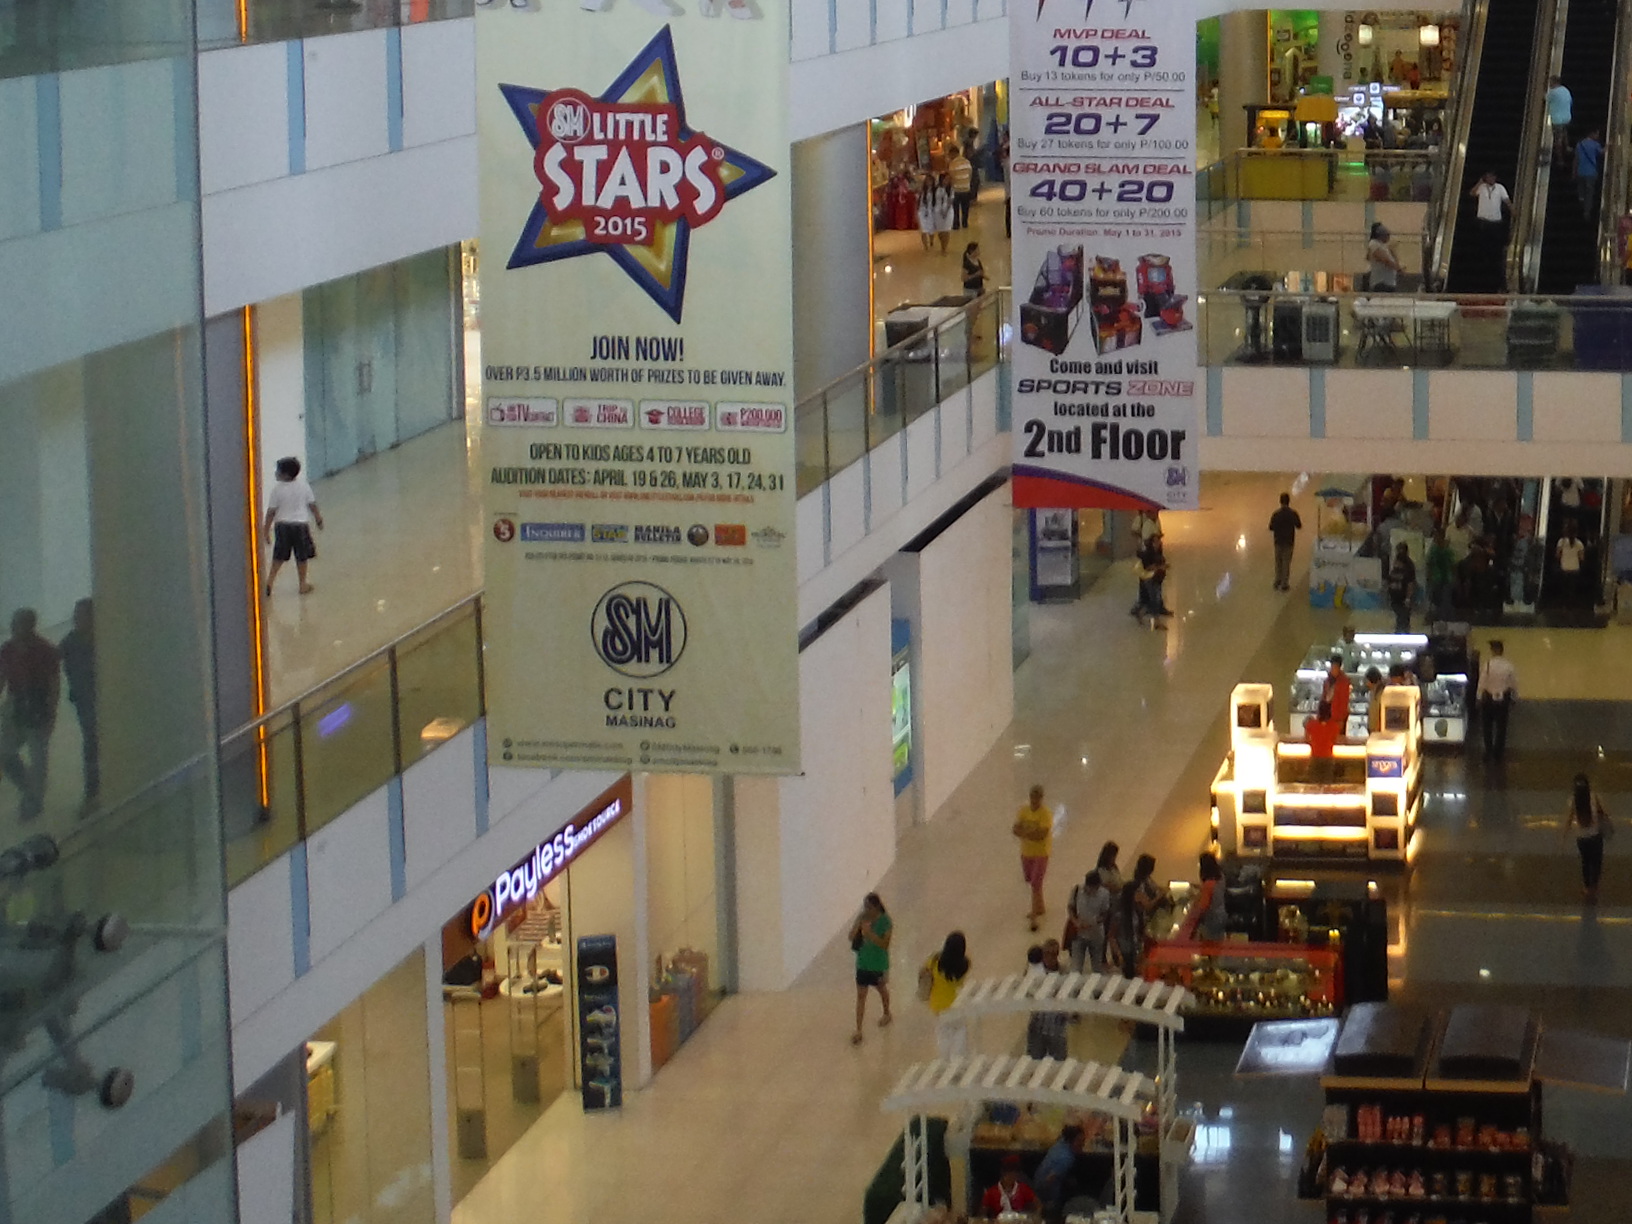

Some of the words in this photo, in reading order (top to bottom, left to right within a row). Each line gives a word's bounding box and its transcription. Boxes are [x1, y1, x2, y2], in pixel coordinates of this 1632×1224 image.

[1053, 28, 1098, 39] MVP
[1101, 29, 1151, 40] DEAL
[1021, 71, 1042, 83] Buy
[1046, 71, 1058, 81] 13
[1061, 71, 1097, 81] tokens
[1101, 72, 1114, 81] for
[1117, 72, 1141, 83] only
[1125, 97, 1175, 108] DEAL
[593, 113, 668, 141] LITTLE
[1018, 138, 1038, 150] Buy
[1058, 139, 1093, 149] tokens
[1097, 139, 1111, 149] for
[1114, 139, 1136, 151] only
[543, 142, 716, 215] STARS
[1013, 163, 1081, 174] GRAND
[1084, 163, 1140, 174] SLAM
[1143, 164, 1192, 174] DEAL
[1018, 206, 1036, 218] Buy
[1040, 207, 1053, 216] 60
[1057, 207, 1093, 217] tokens
[1096, 207, 1109, 217] for
[1113, 208, 1135, 220] only
[594, 216, 647, 240] 2015
[590, 335, 630, 360] JOIN
[635, 337, 684, 362] NOW!
[486, 365, 513, 381] OVER
[543, 366, 587, 382] MILLION
[590, 367, 628, 382] WORTH
[631, 368, 644, 383] OF
[648, 369, 684, 384] PRIZES
[688, 370, 700, 384] TO
[703, 370, 717, 385] BE
[721, 370, 752, 385] GIVEN
[1050, 359, 1091, 375] Come
[1096, 359, 1123, 375] and
[1126, 360, 1158, 375] visit
[1017, 379, 1123, 395] SPORTS
[1127, 381, 1194, 397] ZONE
[1054, 401, 1109, 418] located
[1113, 403, 1129, 418] at
[1131, 403, 1155, 418] the
[1024, 418, 1081, 458] 2nd
[1091, 421, 1186, 460] Floor
[530, 443, 562, 460] OPEN
[565, 444, 579, 460] TO
[582, 444, 610, 461] KIDS
[613, 445, 643, 462] AGES
[646, 446, 654, 462] 4
[657, 446, 672, 463] TO
[676, 447, 683, 463] 7
[686, 447, 725, 464] YEARS
[727, 448, 751, 465] OLD
[491, 467, 545, 484] AUDITION
[633, 470, 646, 487] 19
[683, 471, 708, 488] MAY
[769, 474, 784, 491] 31
[602, 594, 672, 665] SM
[604, 687, 676, 712] CITY
[605, 715, 676, 729] MASINAG
[495, 824, 575, 916] Payless
